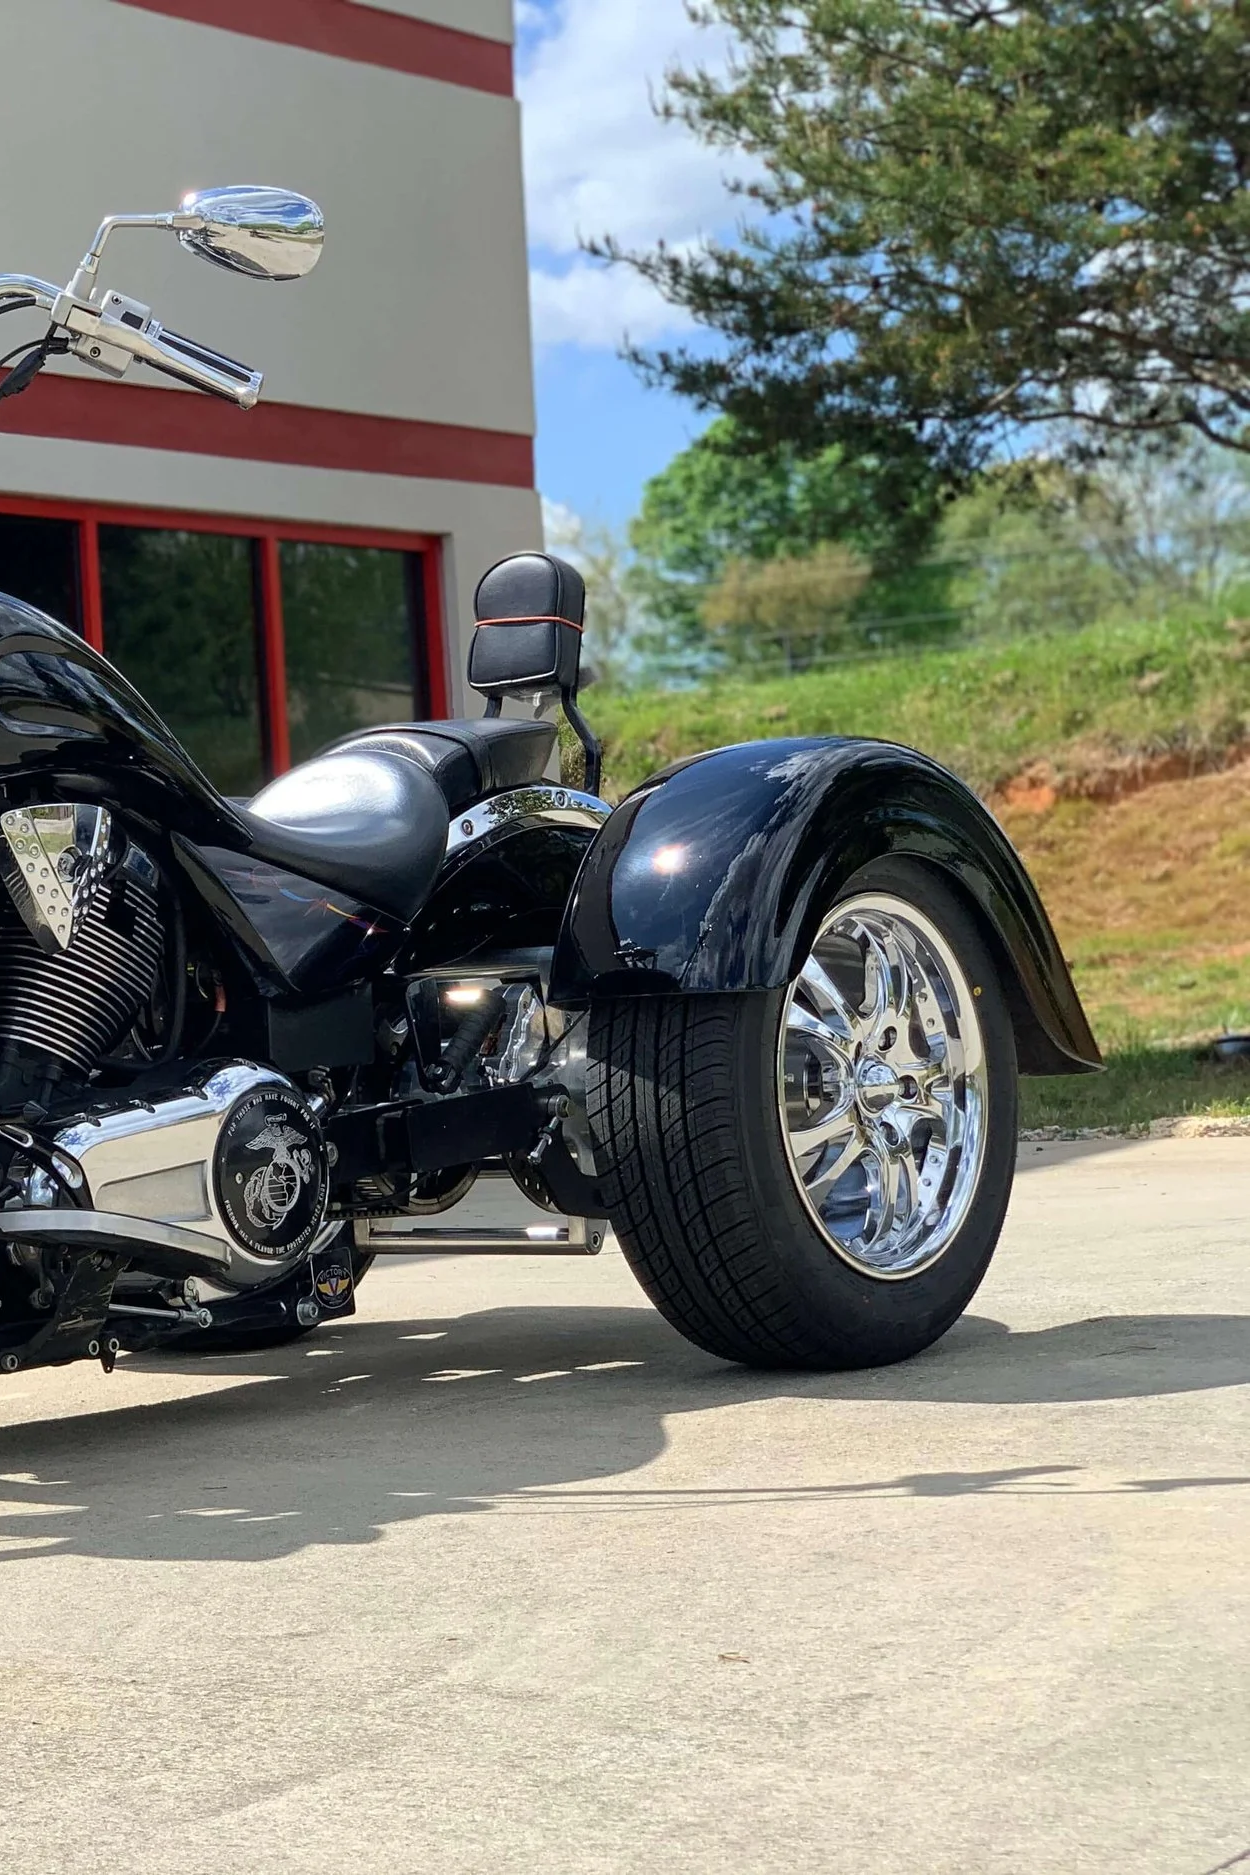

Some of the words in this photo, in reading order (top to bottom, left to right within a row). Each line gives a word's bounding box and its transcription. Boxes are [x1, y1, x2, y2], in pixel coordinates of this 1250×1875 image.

[227, 1122, 237, 1137] FOR
[236, 1103, 251, 1121] THOSE
[252, 1095, 263, 1106] WHO
[264, 1093, 279, 1101] HAVE
[280, 1094, 299, 1111] FOUGHT
[300, 1108, 310, 1122] FOR
[224, 1200, 239, 1230] FREEDOM
[238, 1229, 249, 1241] HAS
[254, 1242, 274, 1255] FLAVOR
[275, 1246, 286, 1255] THE
[286, 1226, 312, 1251] PROTECTED
[311, 1204, 321, 1226] NEVER
[320, 1268, 347, 1282] VICTORY
